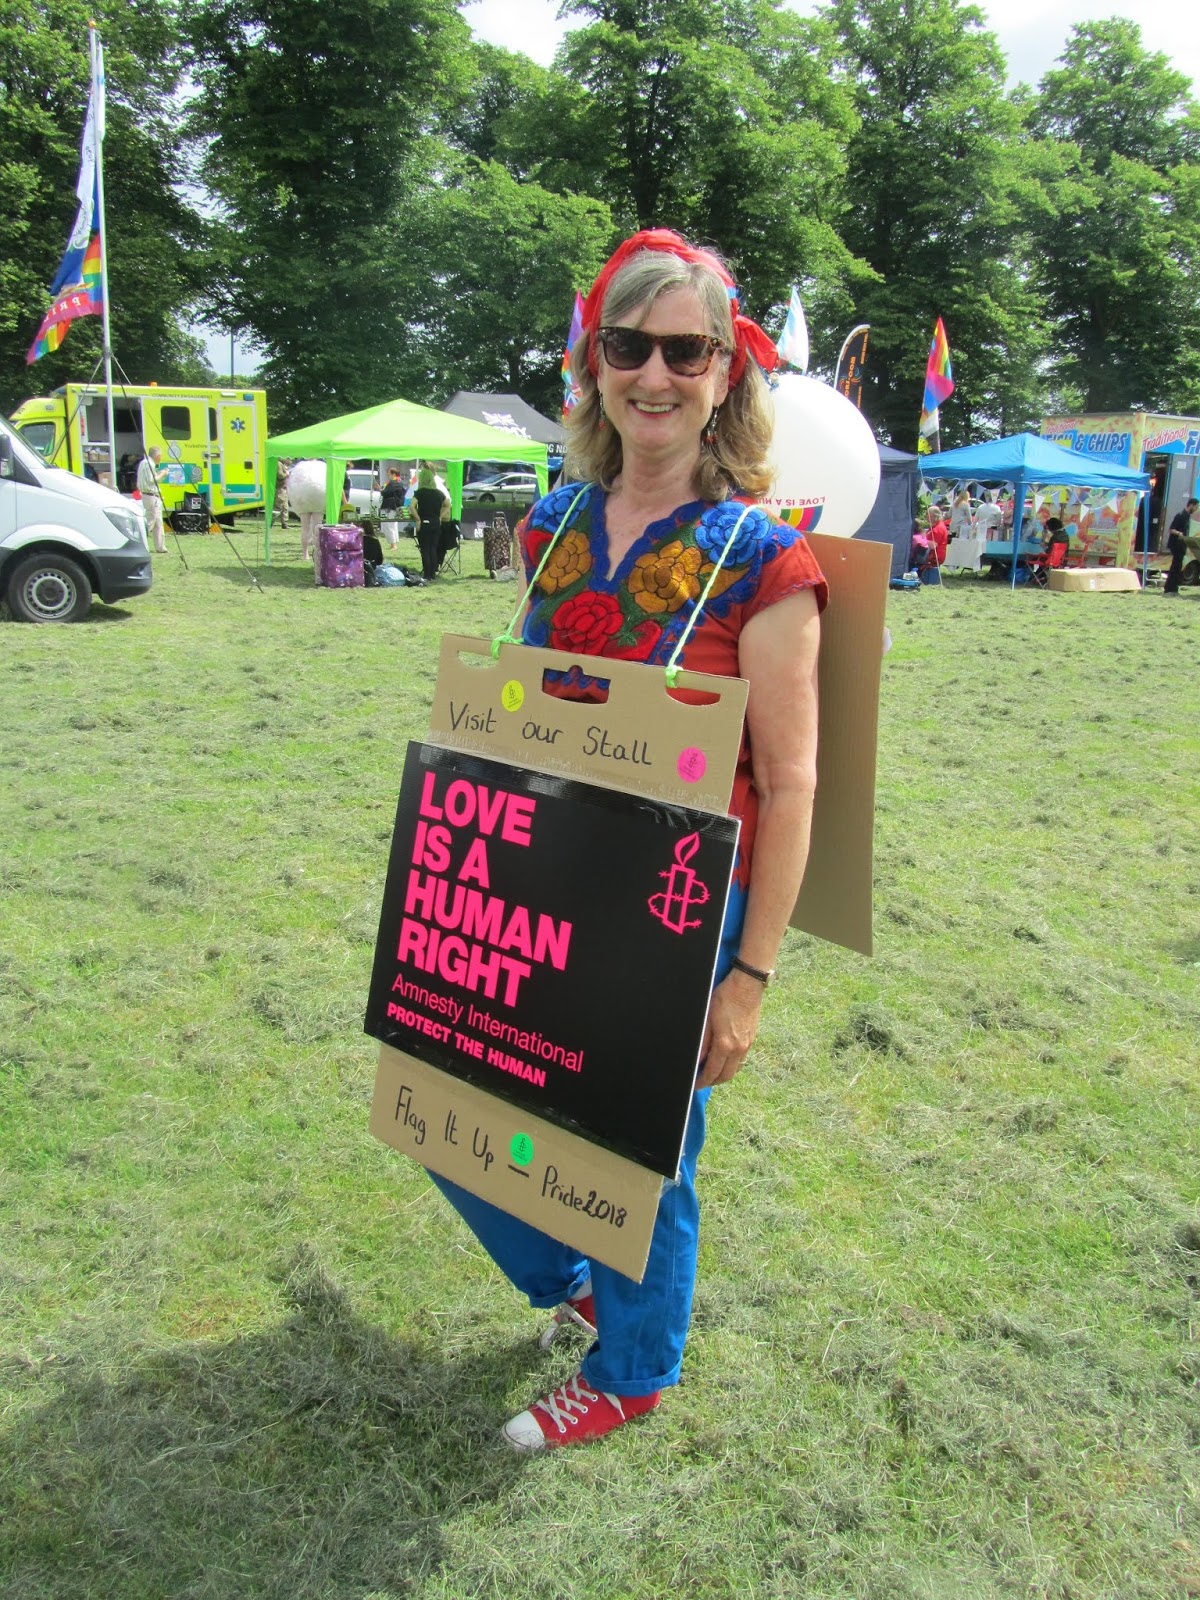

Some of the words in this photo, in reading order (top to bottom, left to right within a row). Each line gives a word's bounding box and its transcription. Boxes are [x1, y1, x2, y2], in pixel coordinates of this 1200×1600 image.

[1087, 431, 1129, 453] CHIPS
[1142, 424, 1188, 451] Traditional
[757, 497, 772, 505] HU
[775, 498, 783, 506] A
[785, 498, 795, 507] IS
[799, 496, 826, 506] LOVE
[449, 701, 497, 734] Visit
[522, 719, 564, 744] our
[582, 725, 652, 766] Stall
[418, 772, 537, 848] LOVE
[411, 821, 452, 873] IS
[457, 838, 490, 889] A
[403, 869, 573, 971] HUMAN
[396, 918, 532, 1008] RIGHT
[387, 1002, 452, 1044] PROTECT
[455, 1033, 484, 1060] THE
[487, 1049, 547, 1088] HUMAN
[391, 973, 464, 1020] Amnesty
[467, 1003, 585, 1073] International
[394, 1085, 427, 1146] Flag
[444, 1109, 458, 1145] It
[473, 1127, 494, 1171] Up
